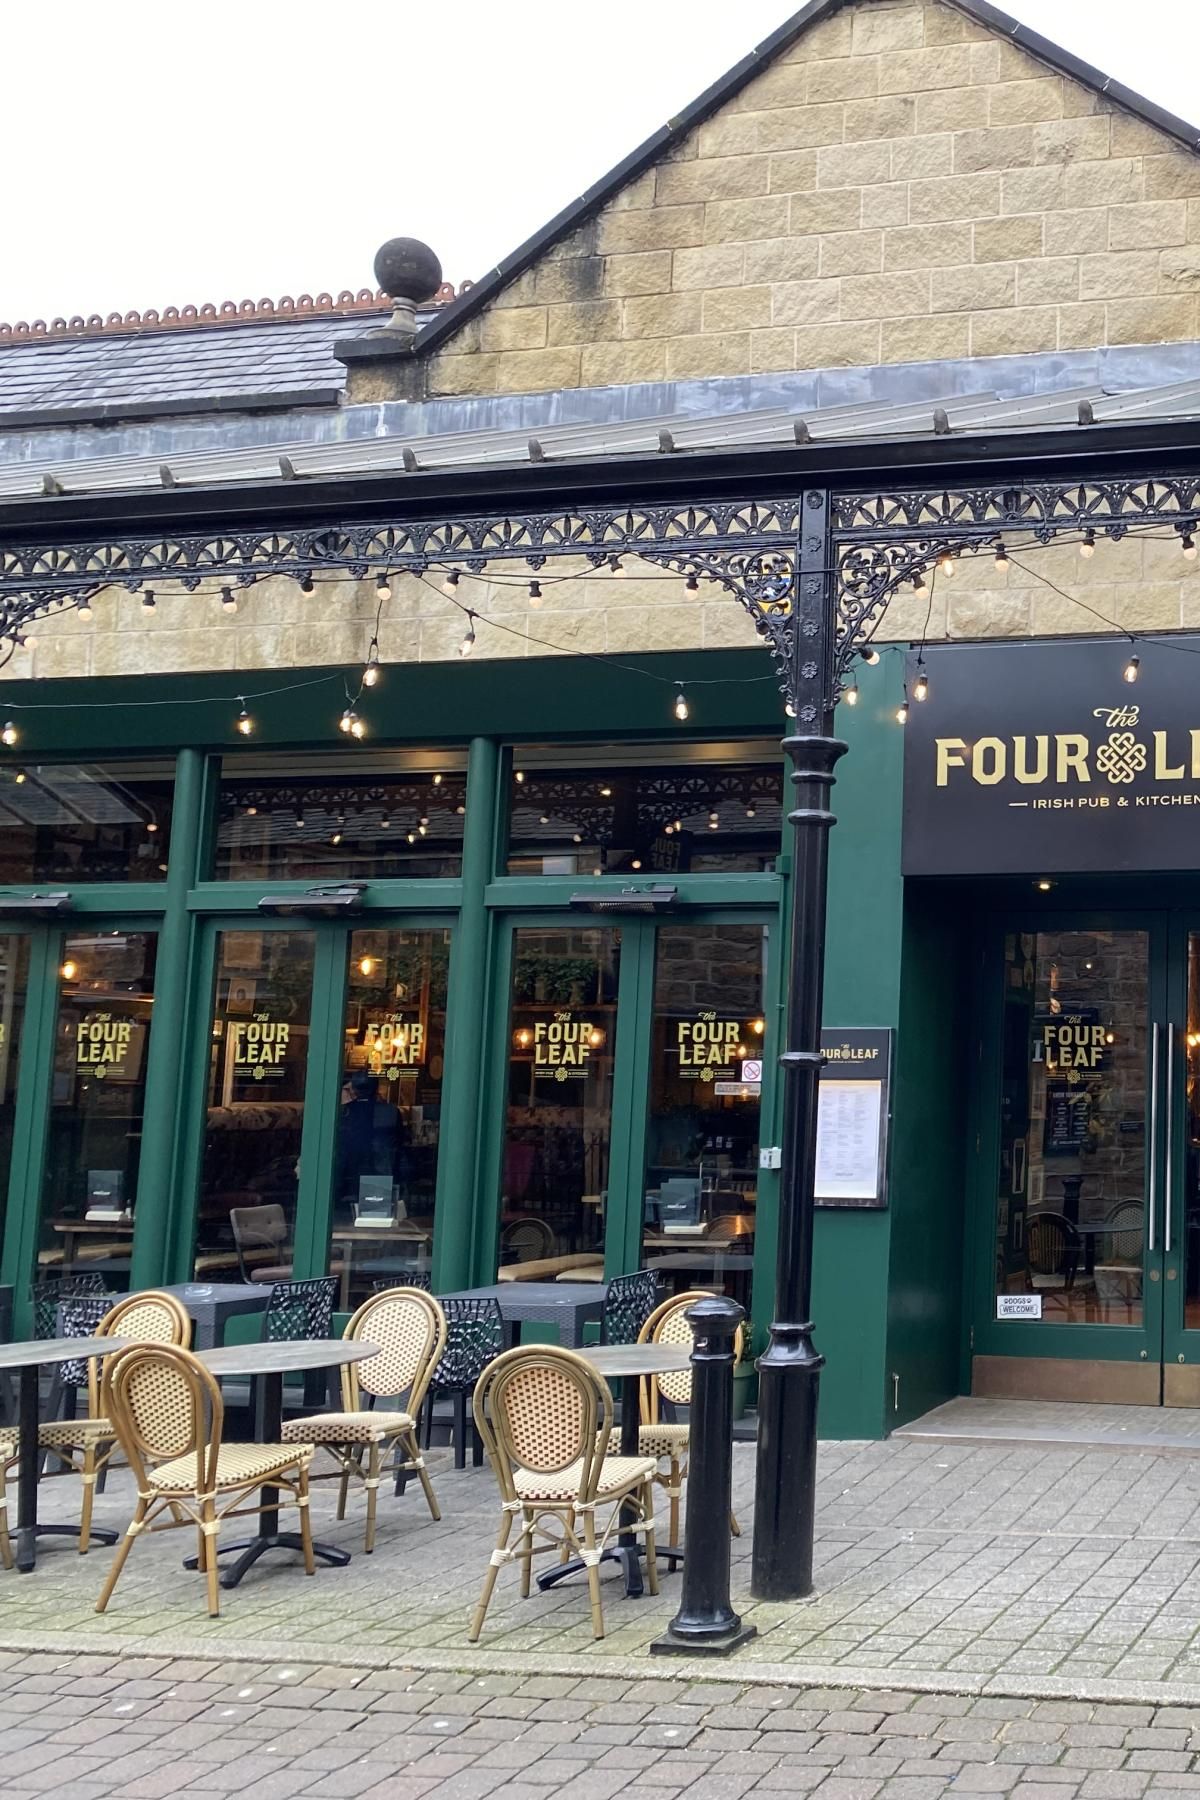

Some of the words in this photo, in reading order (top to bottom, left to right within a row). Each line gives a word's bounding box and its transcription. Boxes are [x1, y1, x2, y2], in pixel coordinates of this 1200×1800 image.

[1093, 705, 1140, 727] the
[934, 733, 1091, 787] FOUR
[1032, 798, 1075, 809] IRISH
[1077, 797, 1110, 807] PUB
[1117, 796, 1129, 807] &
[77, 1023, 131, 1042] FOUR
[235, 1023, 289, 1043] FOUR
[534, 1022, 593, 1043] FOUR
[678, 1022, 739, 1042] FOUR
[1044, 1025, 1106, 1046] FOUR
[77, 1043, 128, 1063] LEAF
[234, 1043, 287, 1063] LEAF
[535, 1043, 590, 1065] LEAF
[679, 1043, 737, 1065] LEAF
[851, 1048, 879, 1059] LEAF
[1045, 1046, 1104, 1067] LEAF
[1002, 1305, 1035, 1313] WELCOME
